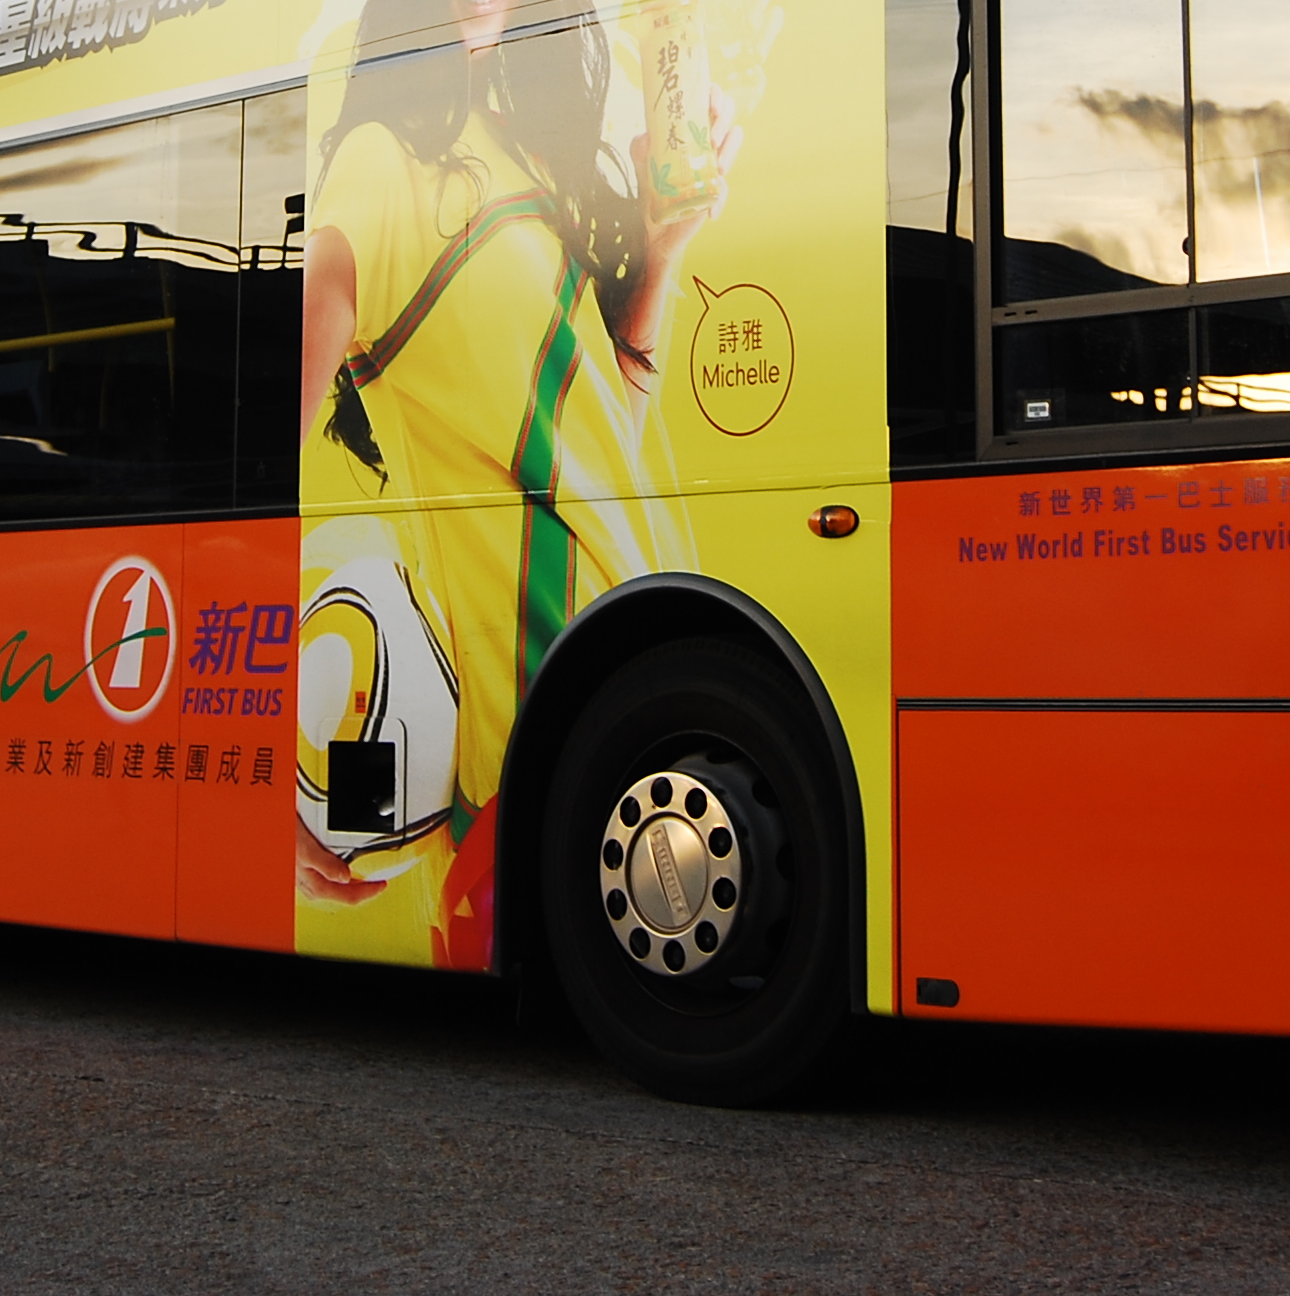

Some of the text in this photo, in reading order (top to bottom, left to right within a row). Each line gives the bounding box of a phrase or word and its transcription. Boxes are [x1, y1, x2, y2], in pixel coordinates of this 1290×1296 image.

[718, 319, 764, 355] 詩雅
[702, 359, 781, 390] Michelle
[958, 534, 1008, 564] New
[1016, 531, 1084, 561] World
[1093, 528, 1151, 558] First
[1161, 525, 1208, 555] Bus
[188, 601, 295, 676] 新巴
[182, 685, 284, 717] FIRST BUS
